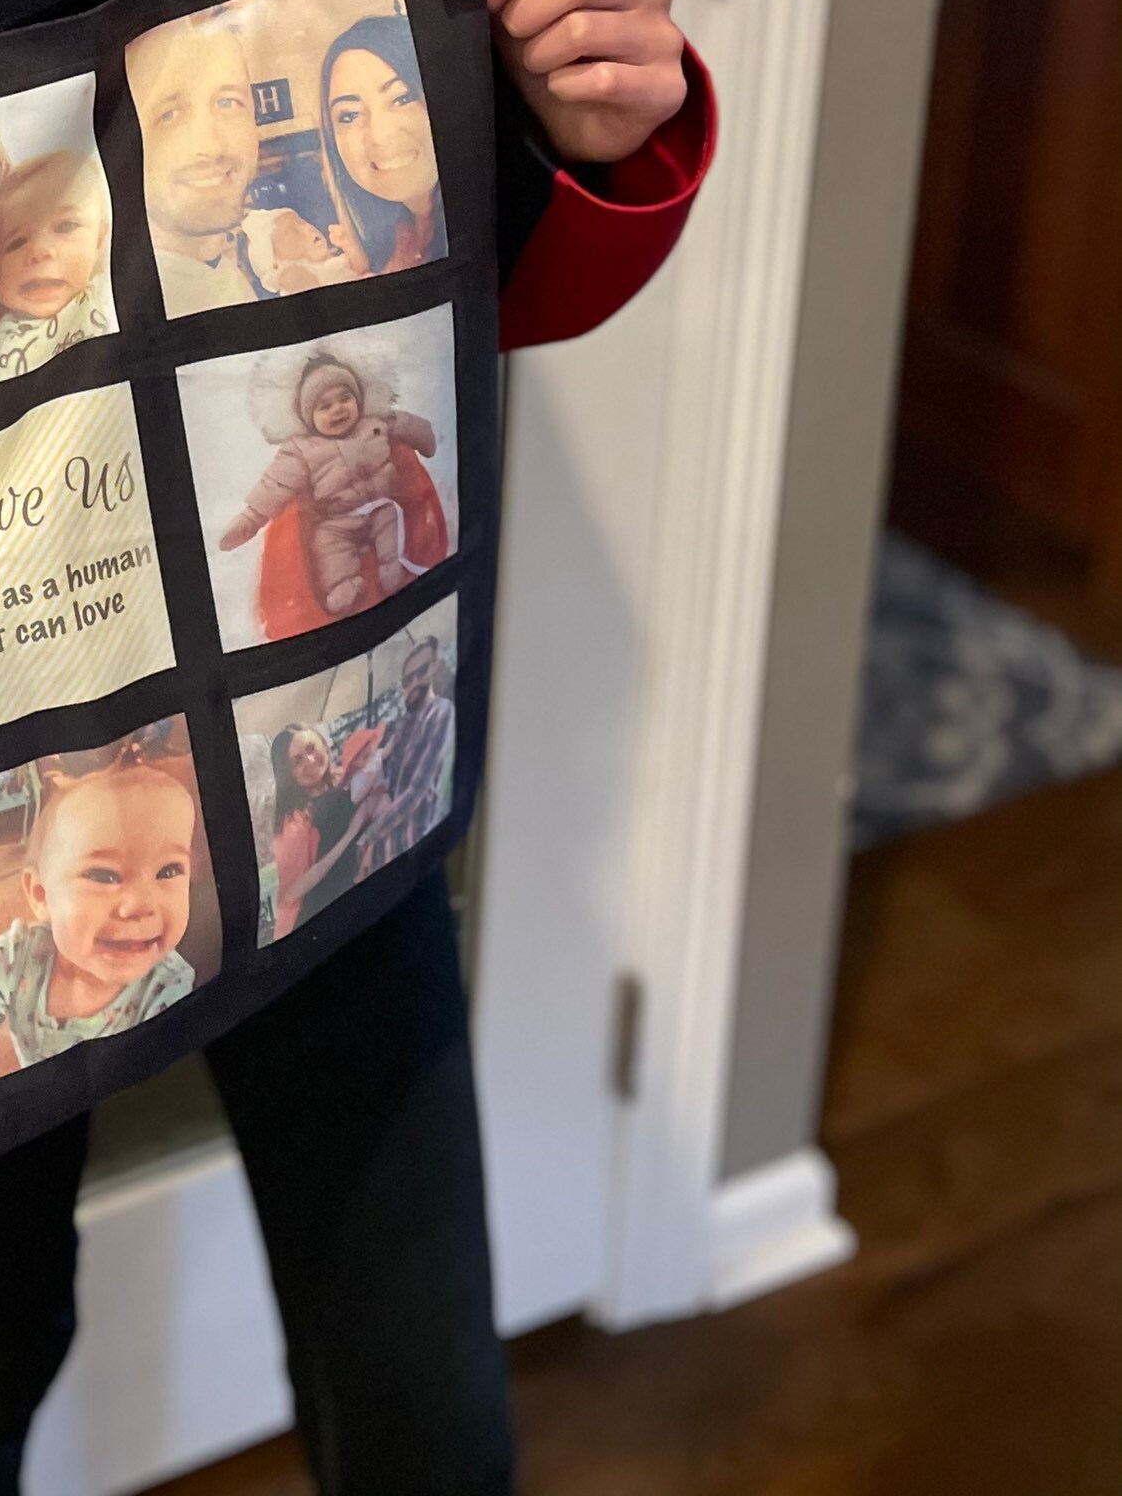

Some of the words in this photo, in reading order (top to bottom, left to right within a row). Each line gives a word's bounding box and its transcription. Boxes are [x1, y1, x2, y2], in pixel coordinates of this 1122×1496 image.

[255, 86, 281, 114] H
[65, 452, 135, 512] Us
[2, 583, 34, 608] as
[42, 577, 60, 599] a
[66, 544, 152, 592] human
[15, 611, 66, 644] can
[73, 591, 126, 632] love
